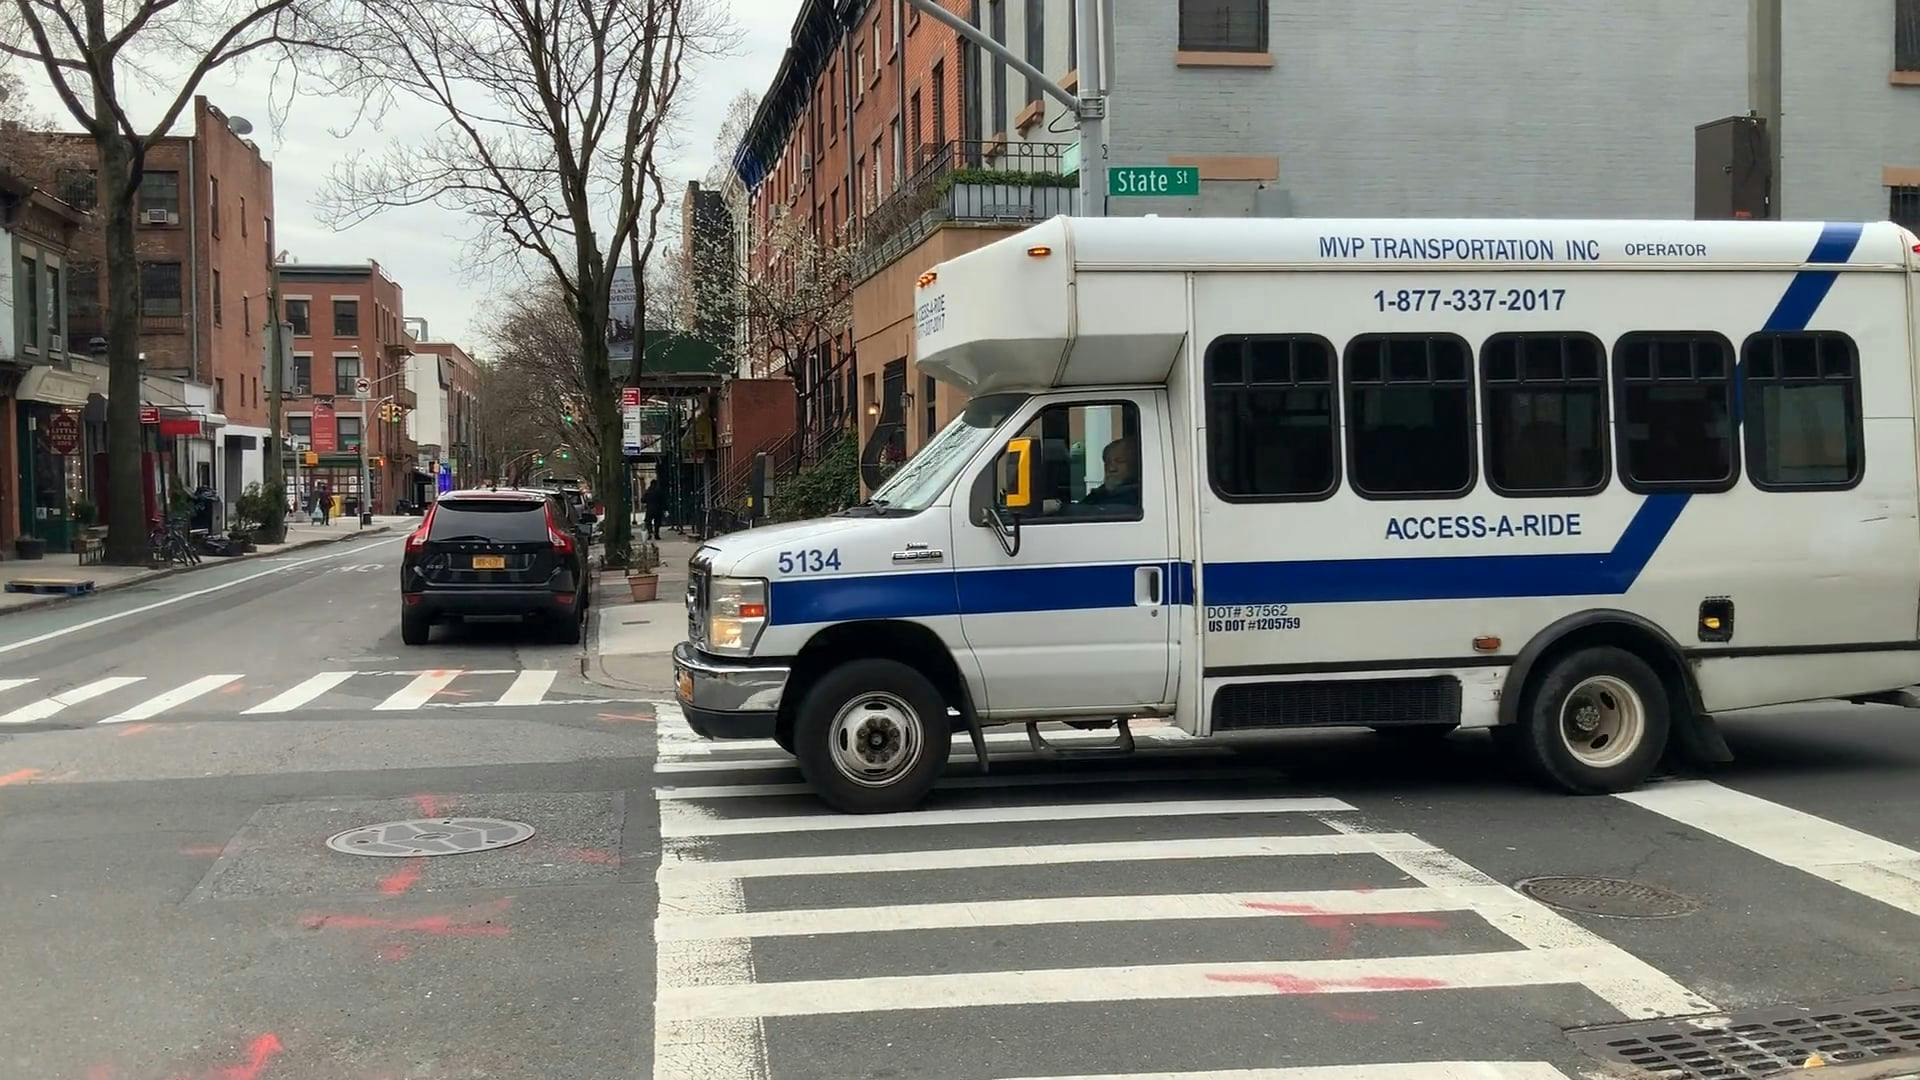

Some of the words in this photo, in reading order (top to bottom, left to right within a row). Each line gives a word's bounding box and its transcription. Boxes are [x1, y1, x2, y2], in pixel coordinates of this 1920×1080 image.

[1118, 170, 1168, 192] State
[1176, 170, 1188, 184] St
[1319, 237, 1365, 258] MVP
[1370, 237, 1554, 260] TRANSPORTATION
[1566, 239, 1600, 261] INC
[1624, 243, 1707, 257] OPERATOR
[1374, 288, 1566, 312] 1-877-337-2017
[1385, 513, 1582, 540] ACCESS-A-RIDE
[778, 548, 842, 573] 5134
[1207, 606, 1242, 619] DOT#
[1246, 604, 1288, 618] 37562
[1208, 620, 1223, 633] US
[1225, 620, 1246, 632] DOT
[1248, 617, 1301, 631] #1205759
